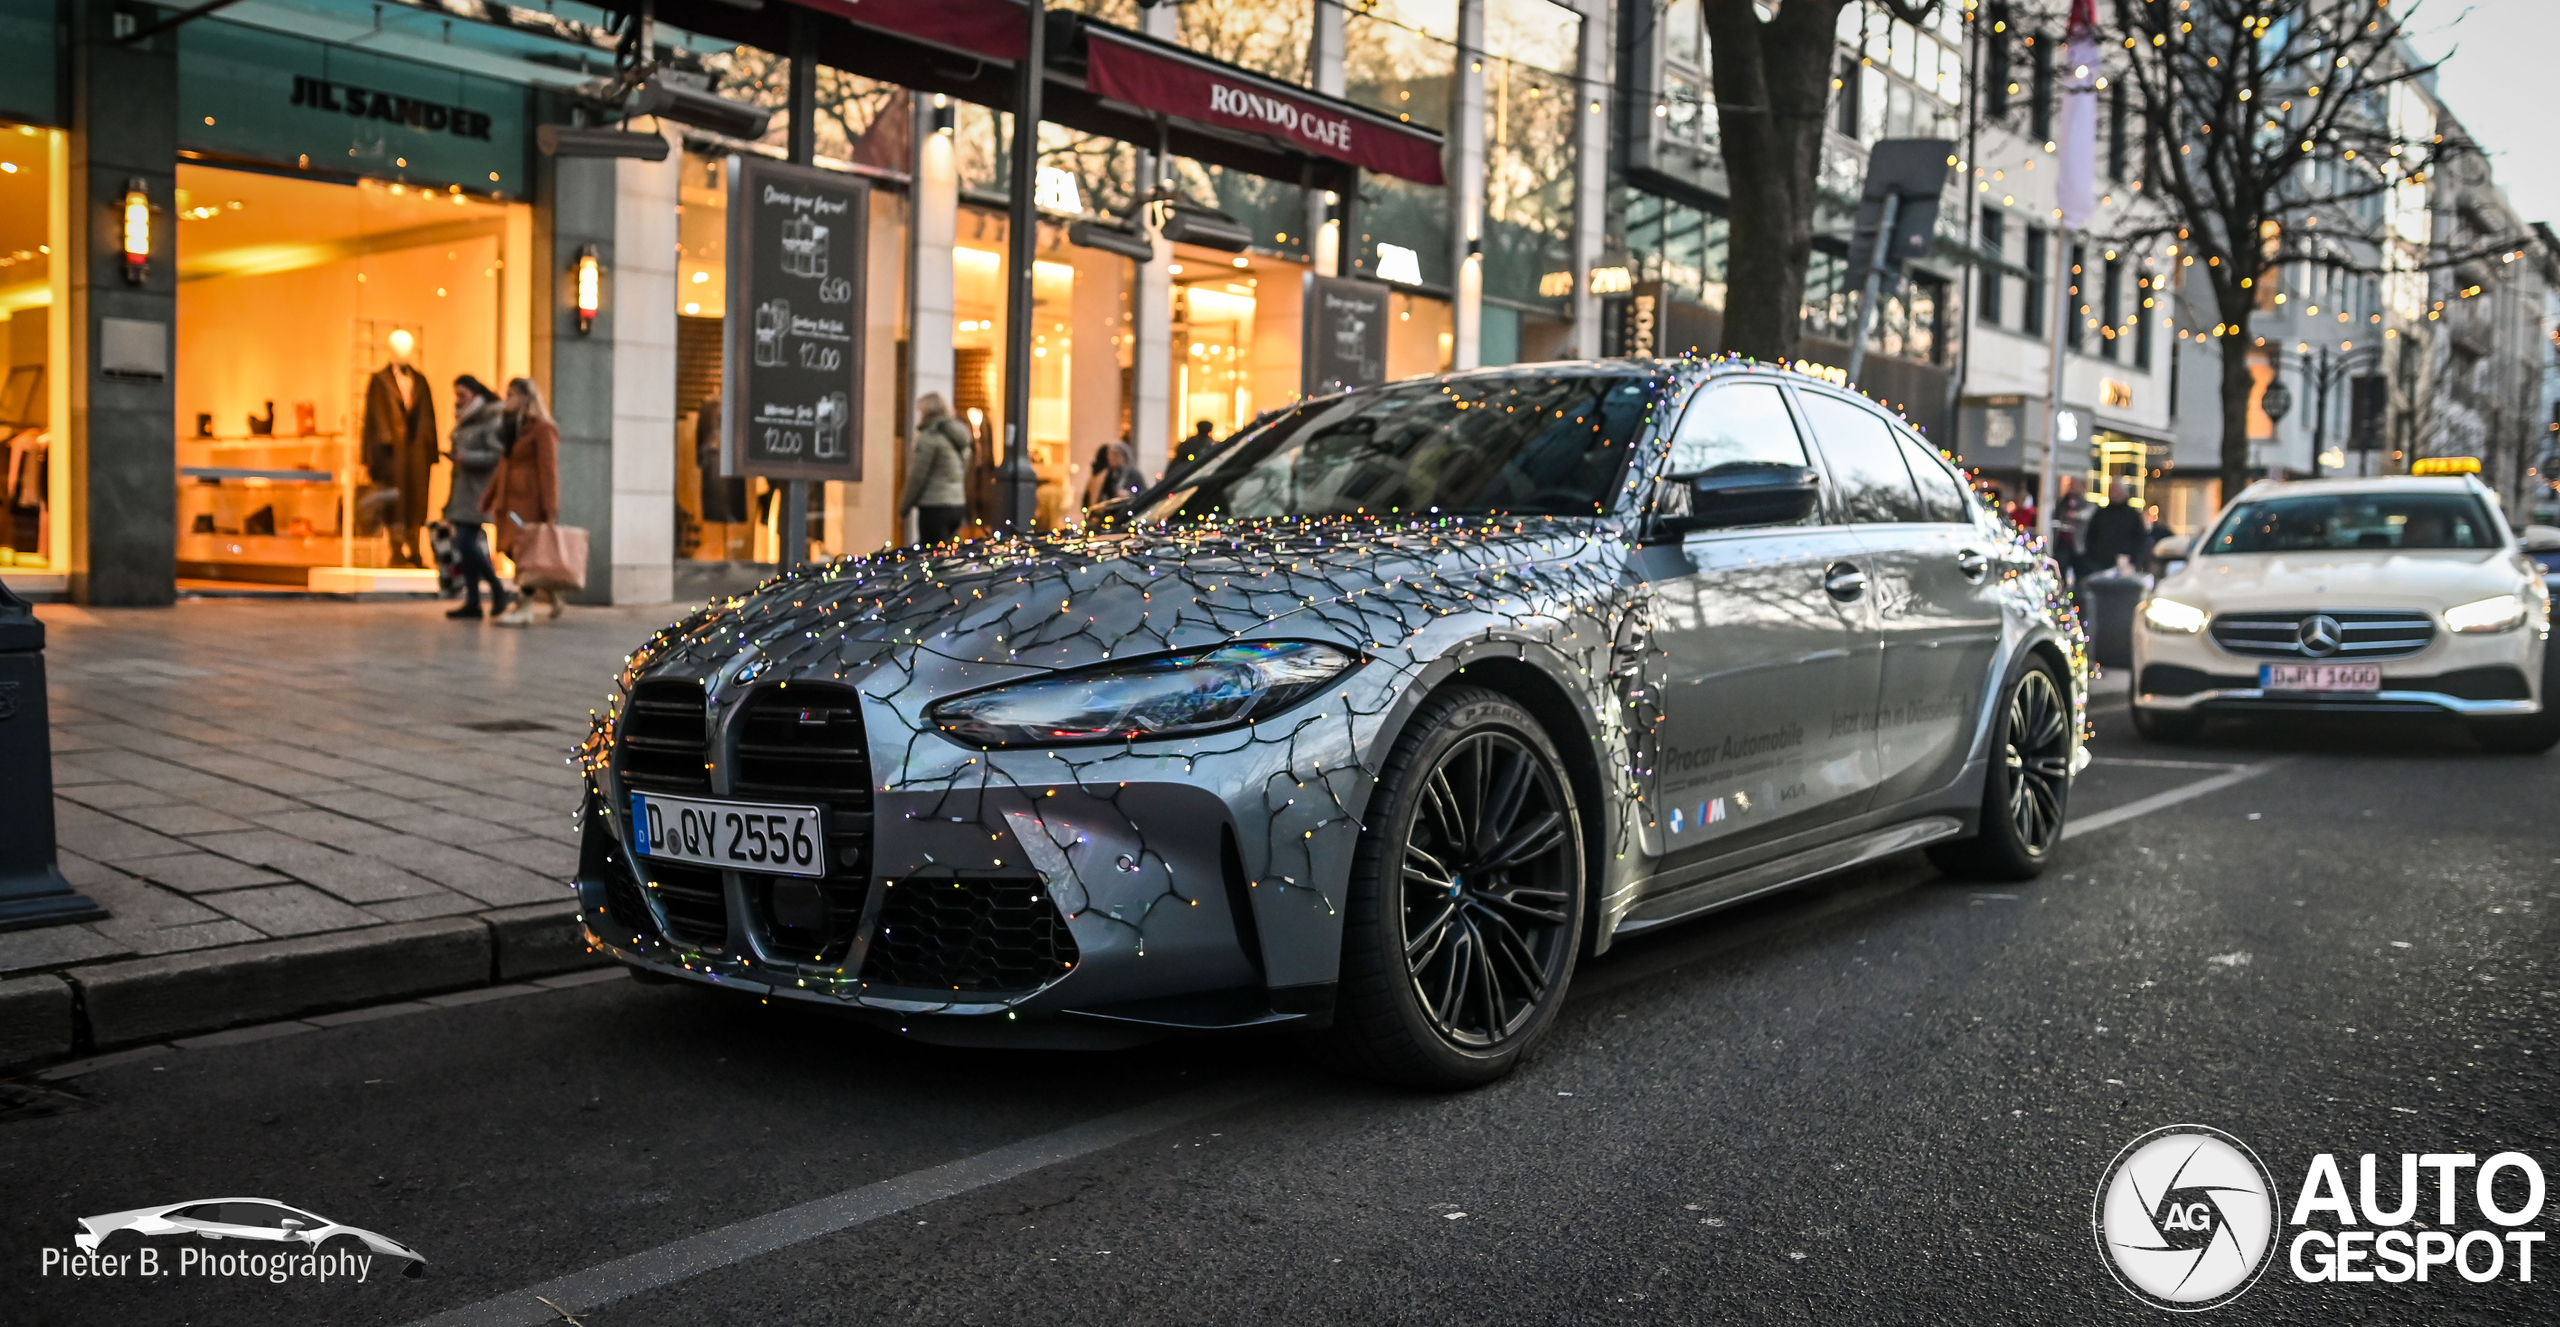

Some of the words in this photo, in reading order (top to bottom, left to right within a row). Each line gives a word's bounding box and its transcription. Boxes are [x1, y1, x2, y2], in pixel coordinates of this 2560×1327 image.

[290, 74, 341, 112] JIL
[345, 86, 491, 141] SANDER
[1210, 84, 1298, 130] RONDO
[1300, 111, 1352, 151] CAFÉ
[1479, 705, 1523, 722] ZERO
[1664, 746, 1717, 774] Procar
[1721, 720, 1804, 763] Automobile
[645, 803, 664, 849] D
[681, 808, 717, 858] QY
[725, 812, 813, 866] 2556
